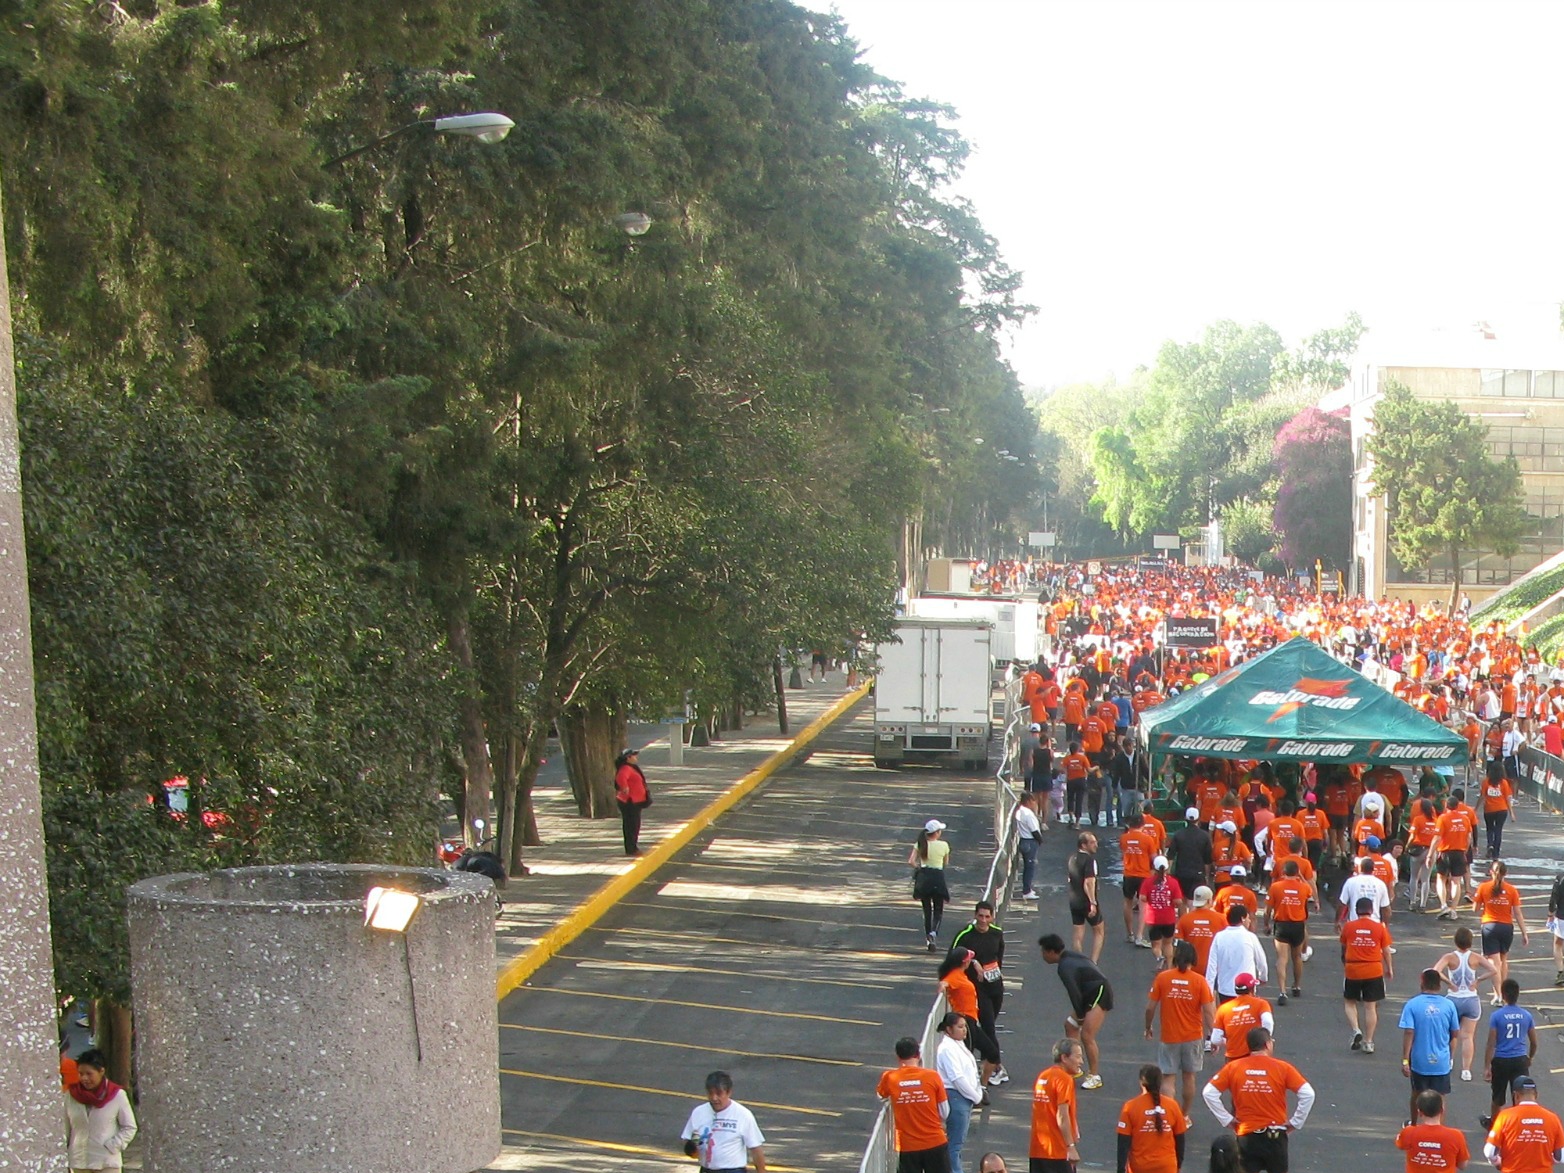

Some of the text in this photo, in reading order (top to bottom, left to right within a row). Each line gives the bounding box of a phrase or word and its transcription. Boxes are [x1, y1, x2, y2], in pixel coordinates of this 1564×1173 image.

[1249, 689, 1362, 710] Gatorade
[1169, 735, 1248, 752] Gatorade
[1277, 740, 1355, 757] Gatorade
[1379, 743, 1455, 759] Gatorade
[1506, 1023, 1520, 1039] 21
